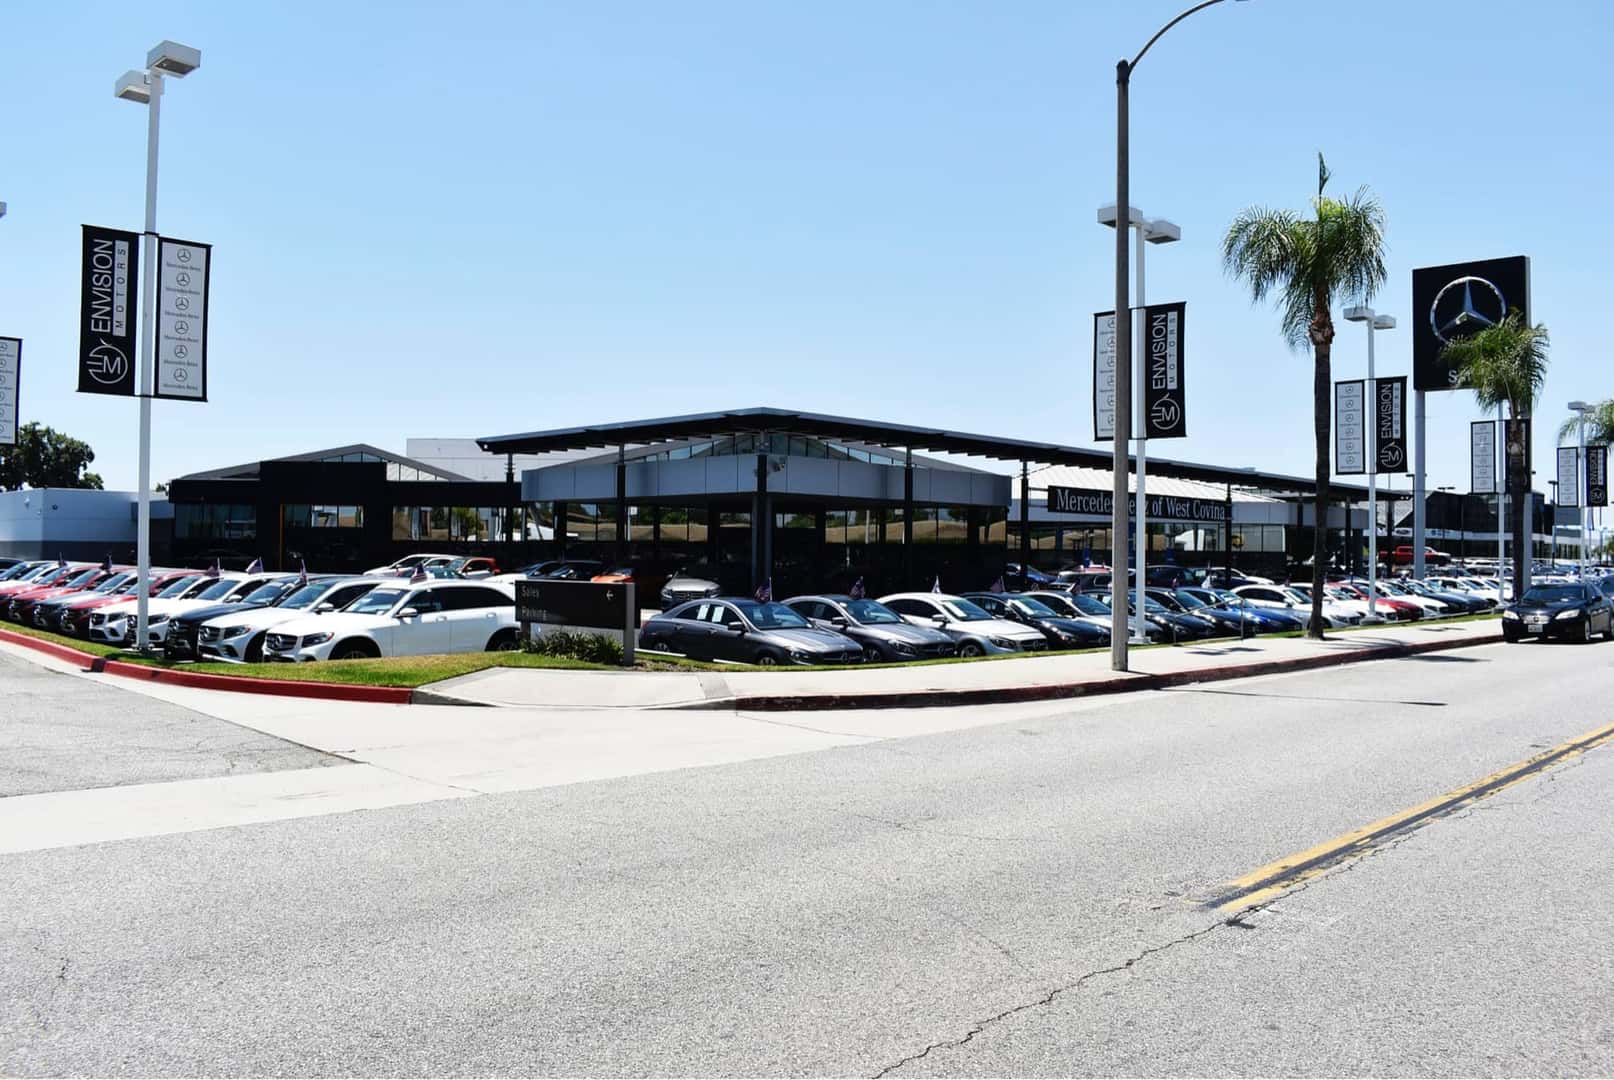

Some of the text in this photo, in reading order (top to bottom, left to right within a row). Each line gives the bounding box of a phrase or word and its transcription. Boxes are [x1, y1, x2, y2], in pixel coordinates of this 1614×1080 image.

[91, 239, 113, 333] ENVISION
[115, 248, 127, 329] MOTORS
[1152, 314, 1167, 390] ENVISION
[1381, 384, 1393, 439] ENVISION
[1152, 497, 1163, 516] of
[1166, 498, 1190, 517] West
[1193, 501, 1225, 520] Covina
